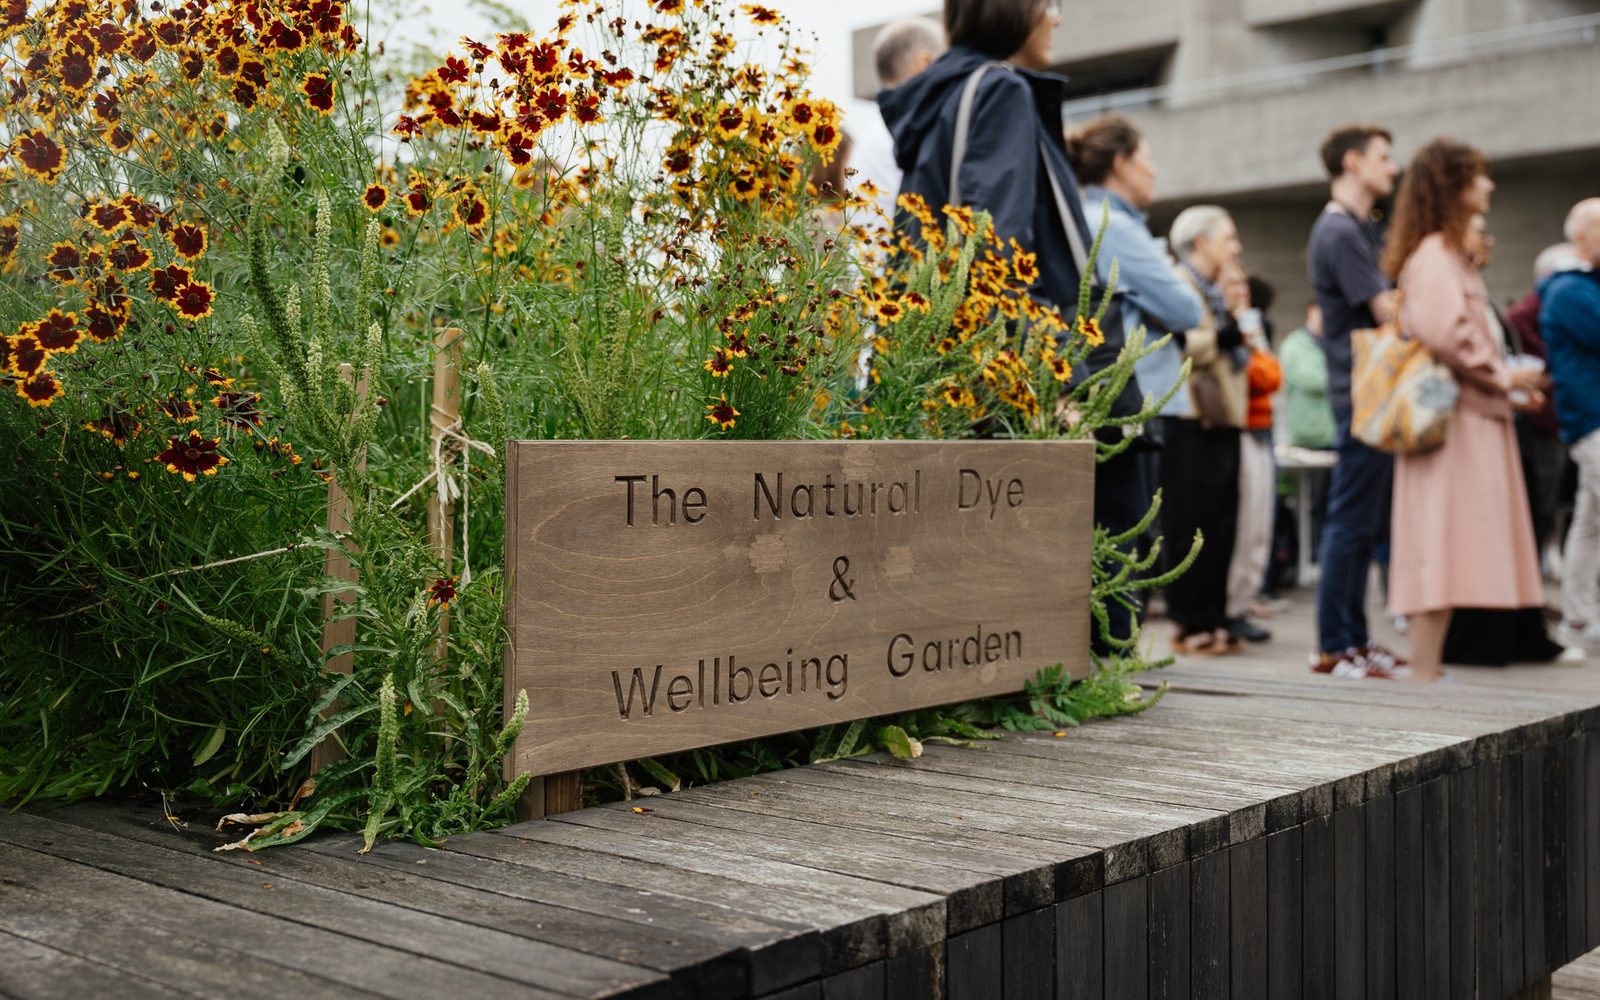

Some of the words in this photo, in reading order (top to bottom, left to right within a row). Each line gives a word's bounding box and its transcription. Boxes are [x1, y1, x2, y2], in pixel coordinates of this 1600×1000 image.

[614, 474, 708, 528] The
[753, 468, 921, 522] Natural
[958, 467, 1025, 520] Dye
[828, 555, 857, 603] &
[611, 648, 849, 720] Wellbeing
[887, 624, 1022, 678] Garden
